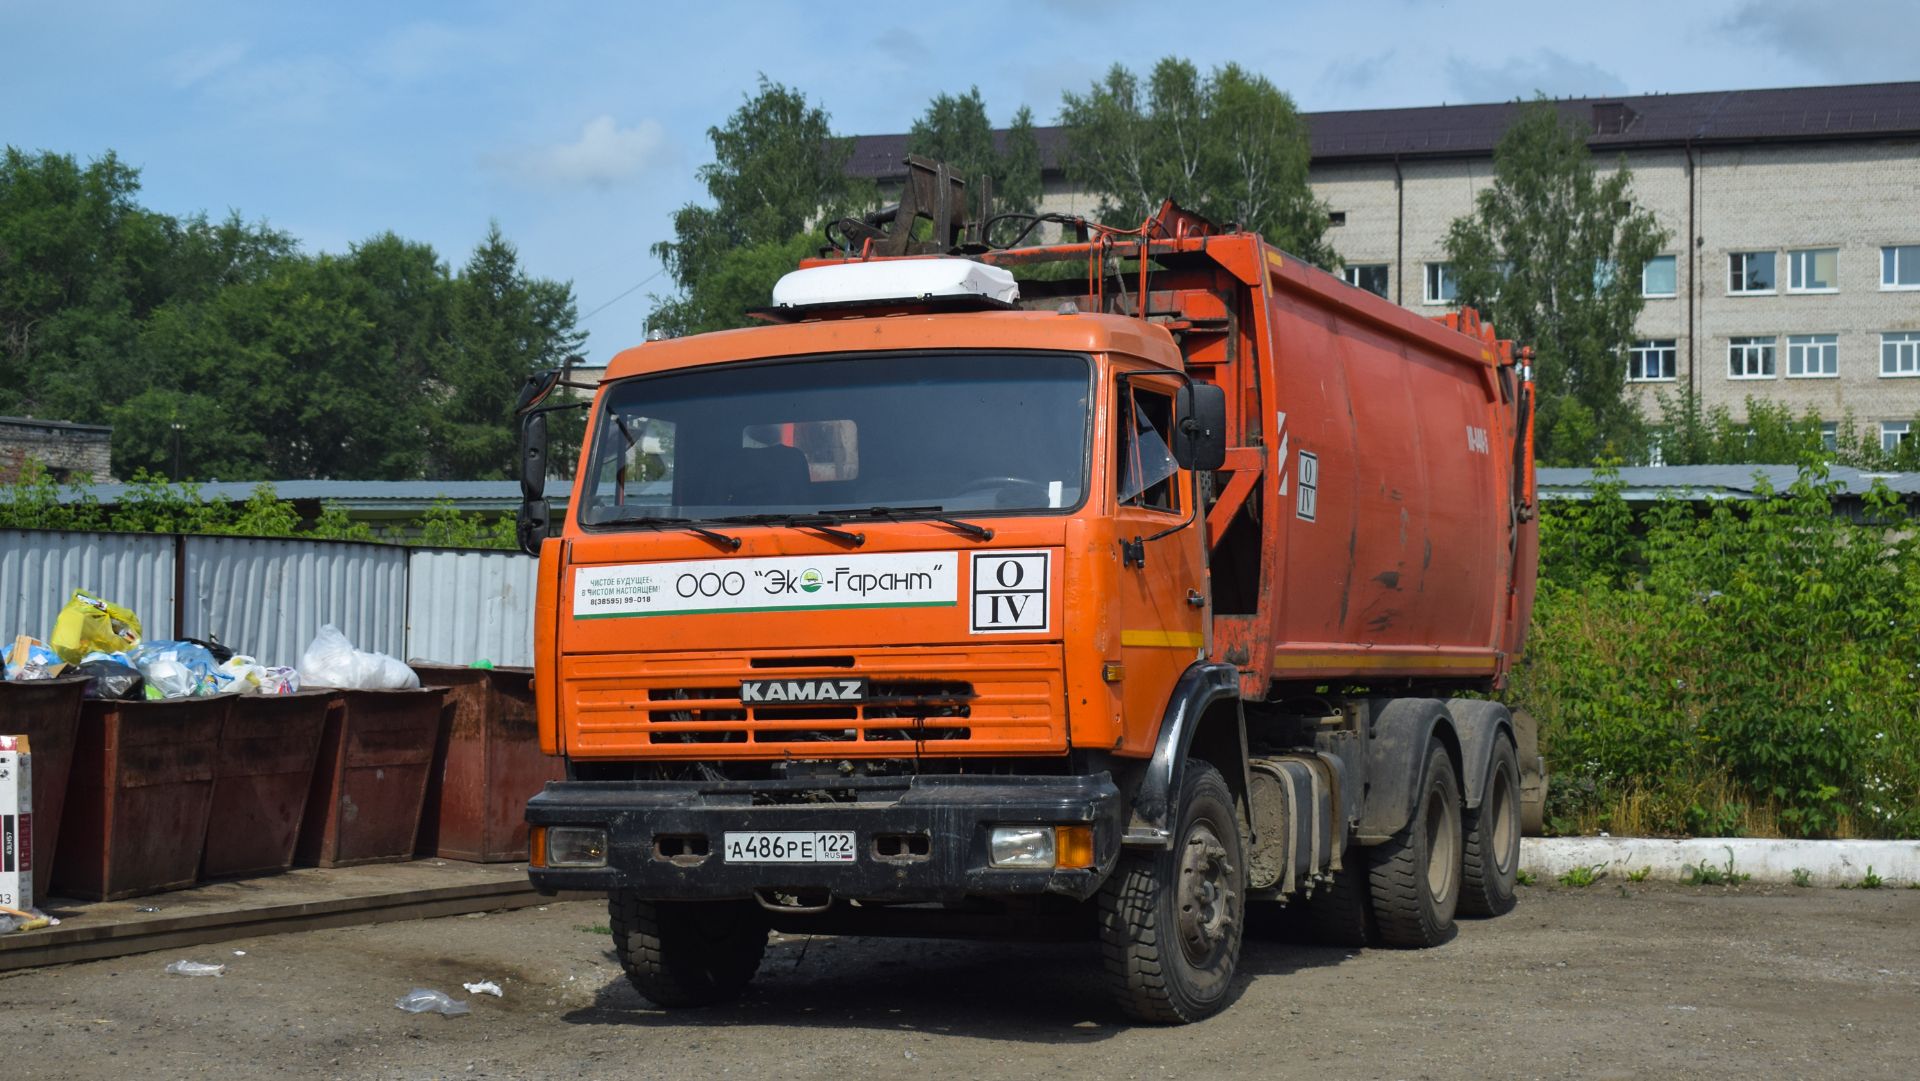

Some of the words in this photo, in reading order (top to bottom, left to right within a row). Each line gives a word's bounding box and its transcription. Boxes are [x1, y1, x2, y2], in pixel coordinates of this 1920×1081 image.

[1301, 487, 1313, 512] IV
[581, 589, 586, 597] В
[587, 587, 615, 597] ЧИСТОМ
[616, 585, 661, 595] НАСТОЯЩЕМ!
[590, 577, 615, 587] ЧИСТОЕ
[676, 571, 745, 598] ООО
[624, 596, 651, 604] 99-018
[988, 594, 1031, 624] IV
[742, 681, 862, 701] KAMAZ
[732, 836, 813, 859] А486РЕ
[818, 834, 849, 852] 122
